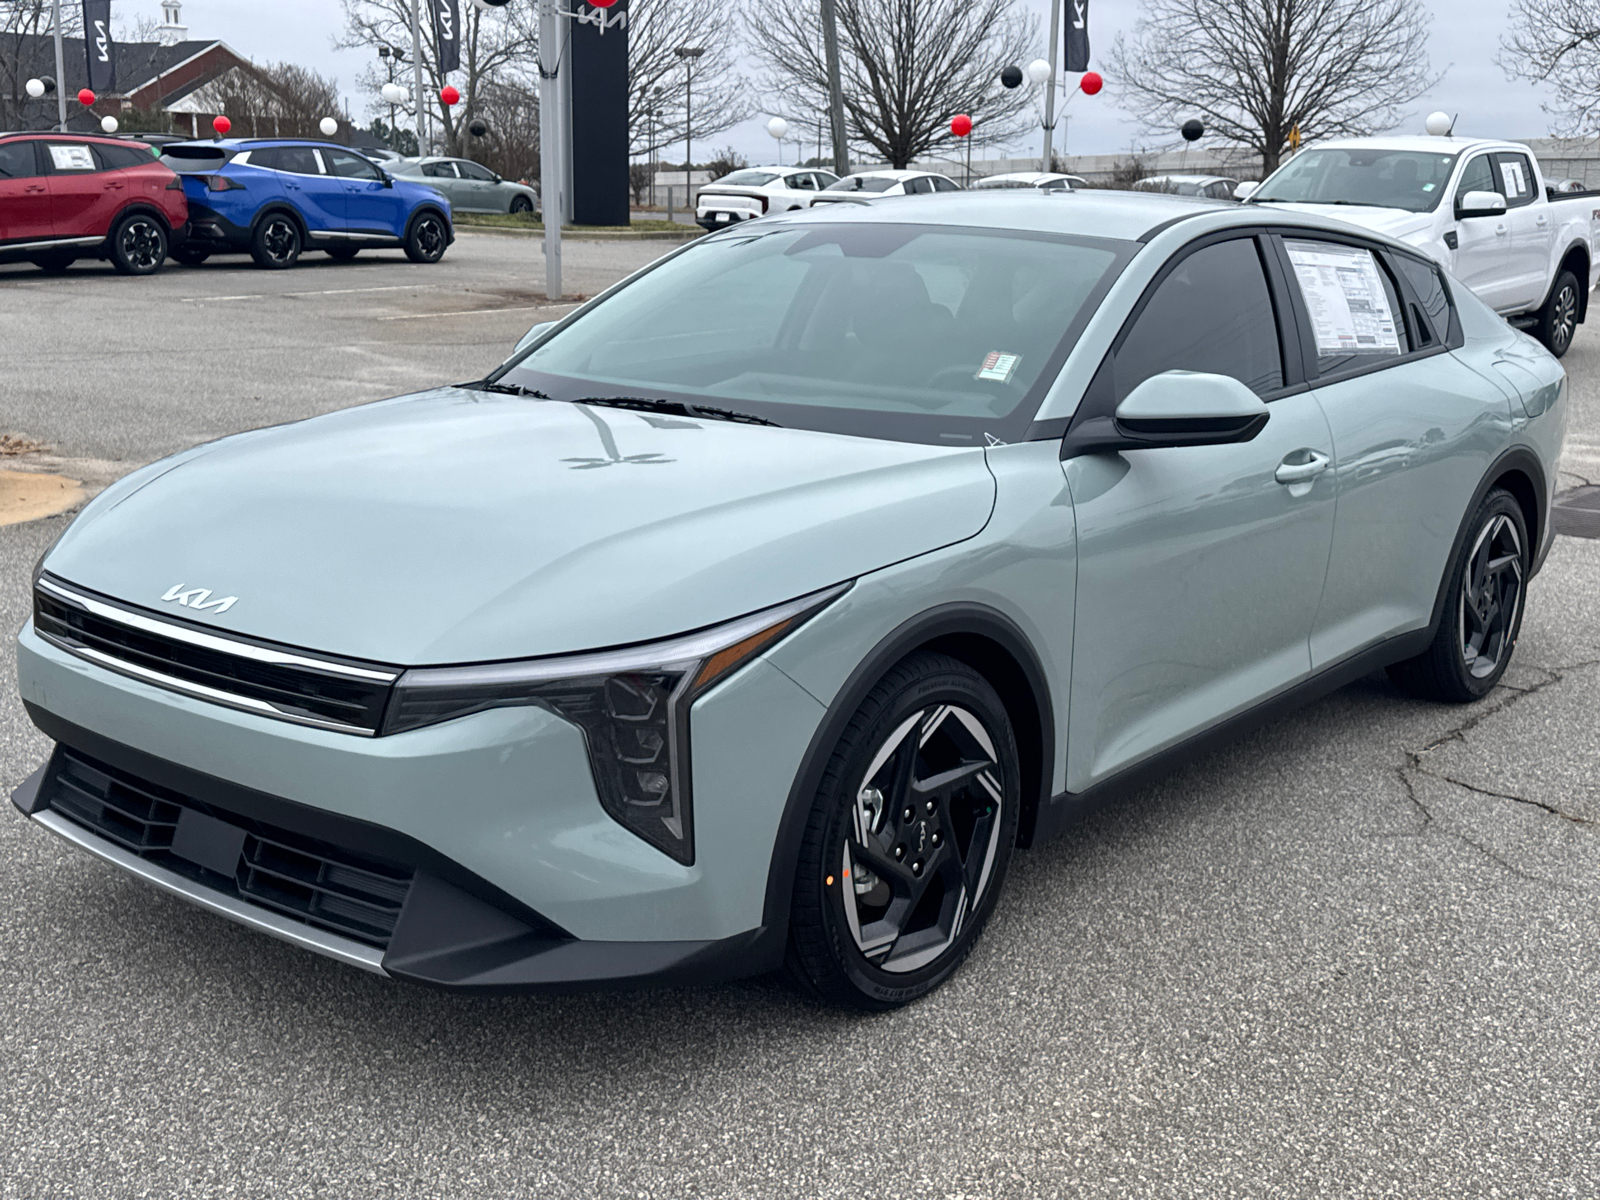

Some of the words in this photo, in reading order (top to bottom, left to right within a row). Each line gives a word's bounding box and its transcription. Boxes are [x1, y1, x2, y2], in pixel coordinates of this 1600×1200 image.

[577, 4, 627, 31] KIA
[94, 20, 109, 62] KIA
[162, 582, 239, 615] KIA
